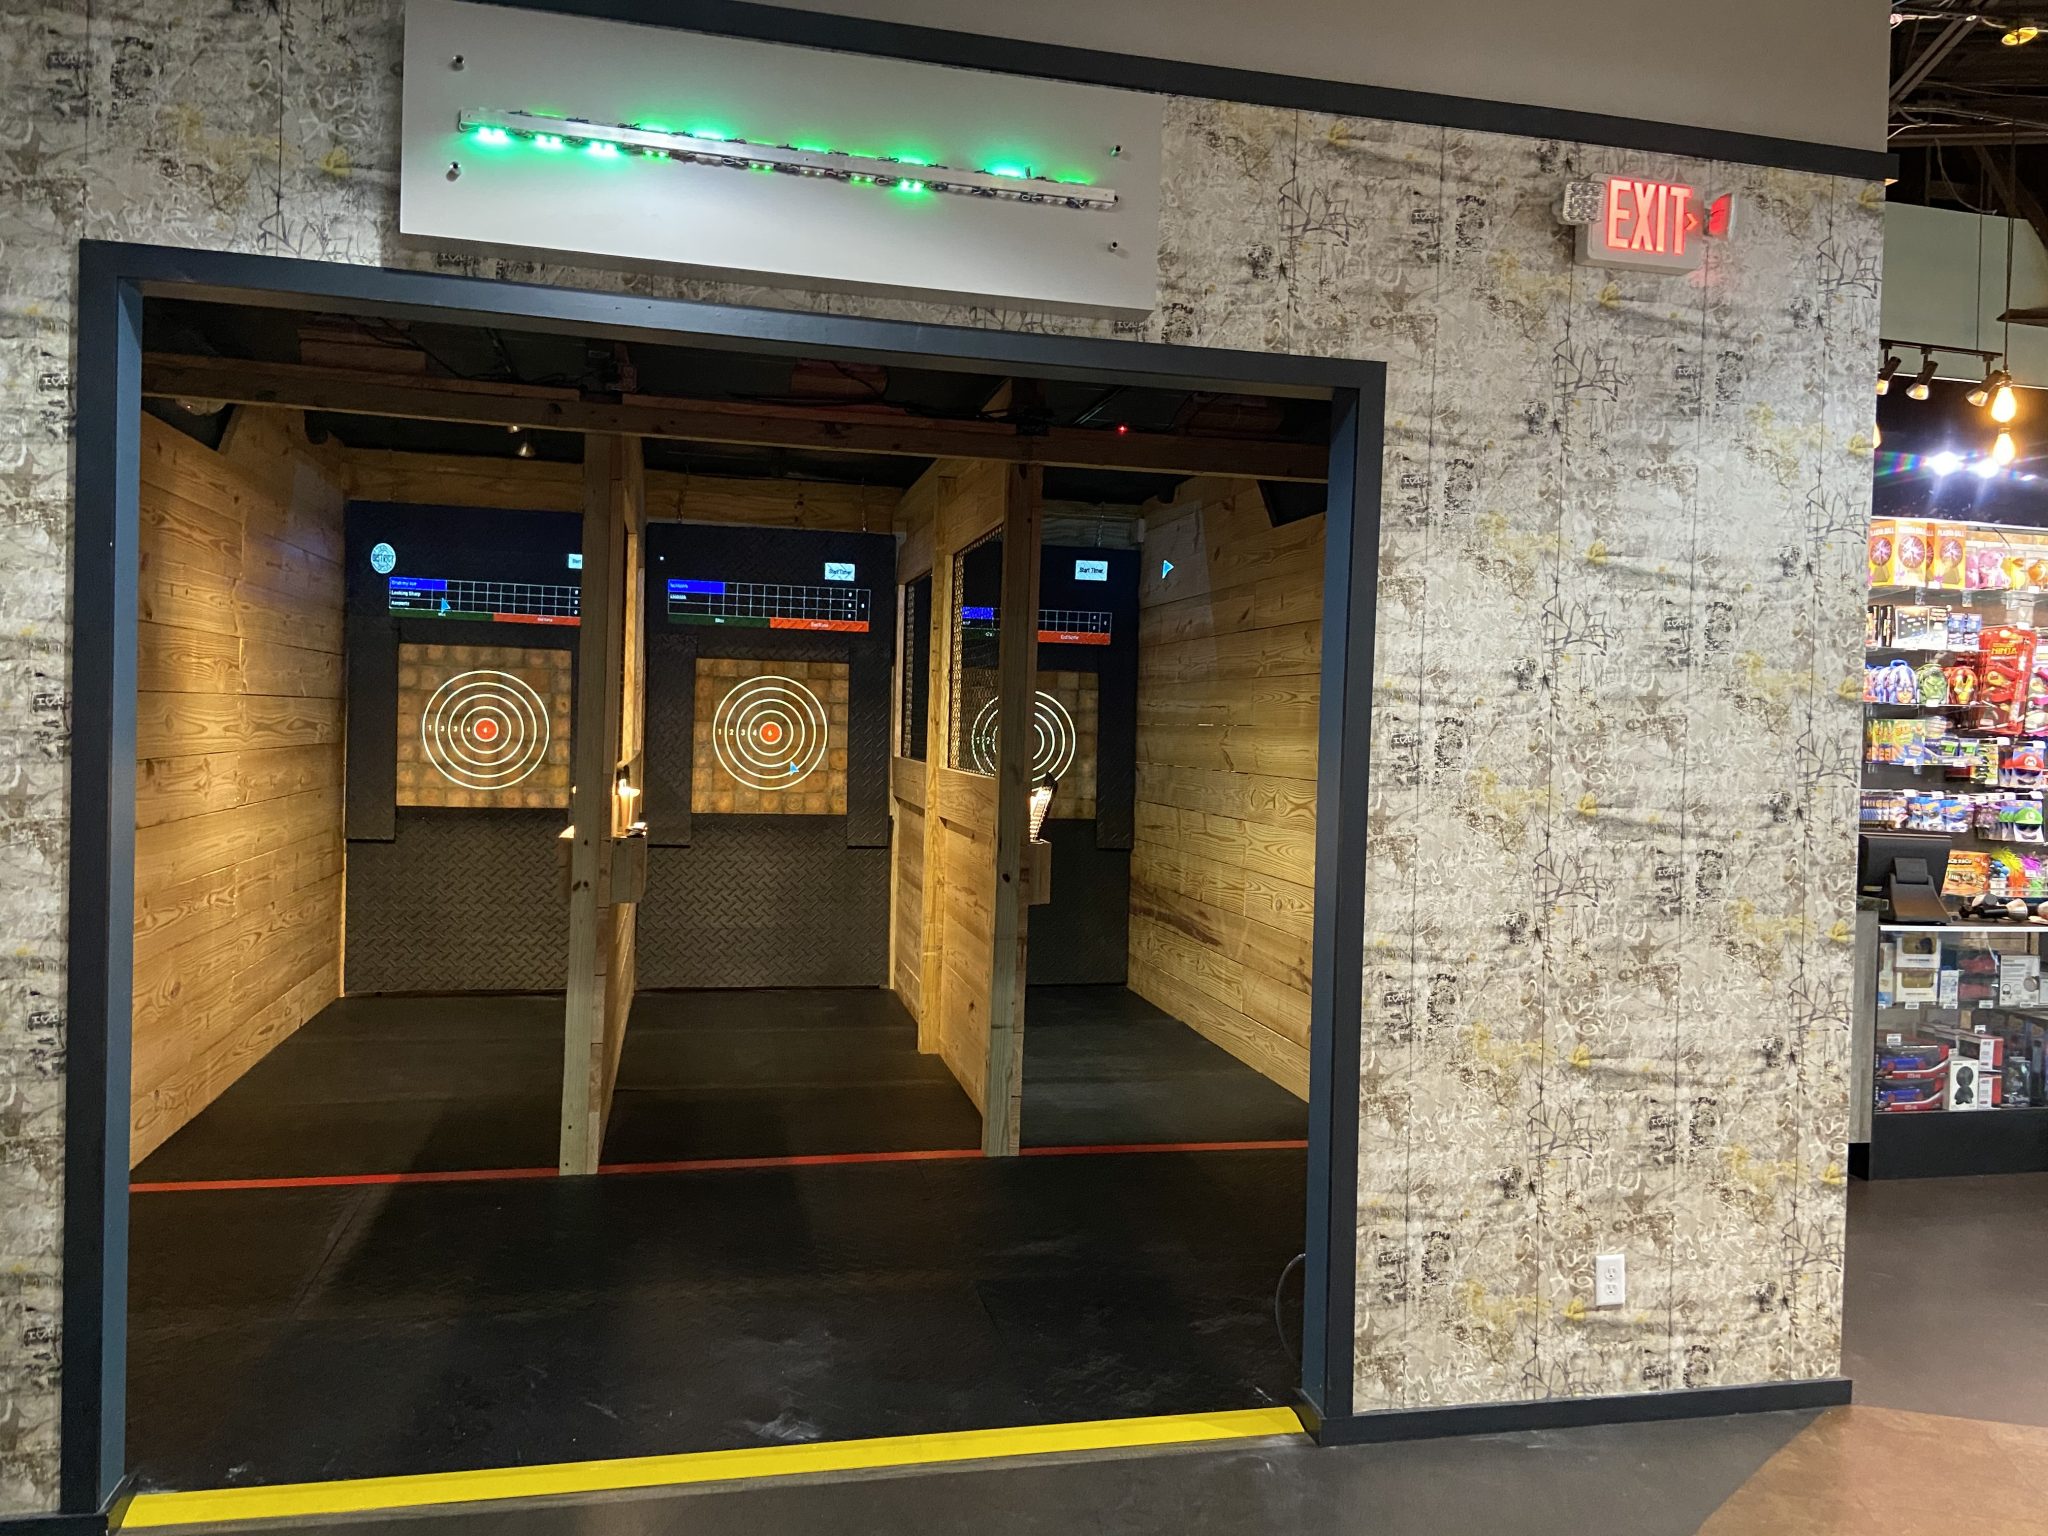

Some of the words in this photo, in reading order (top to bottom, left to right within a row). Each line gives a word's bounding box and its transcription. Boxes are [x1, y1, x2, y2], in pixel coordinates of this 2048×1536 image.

[1607, 178, 1693, 256] EXIT
[408, 590, 421, 598] Sharp
[1991, 647, 2017, 655] NINJA
